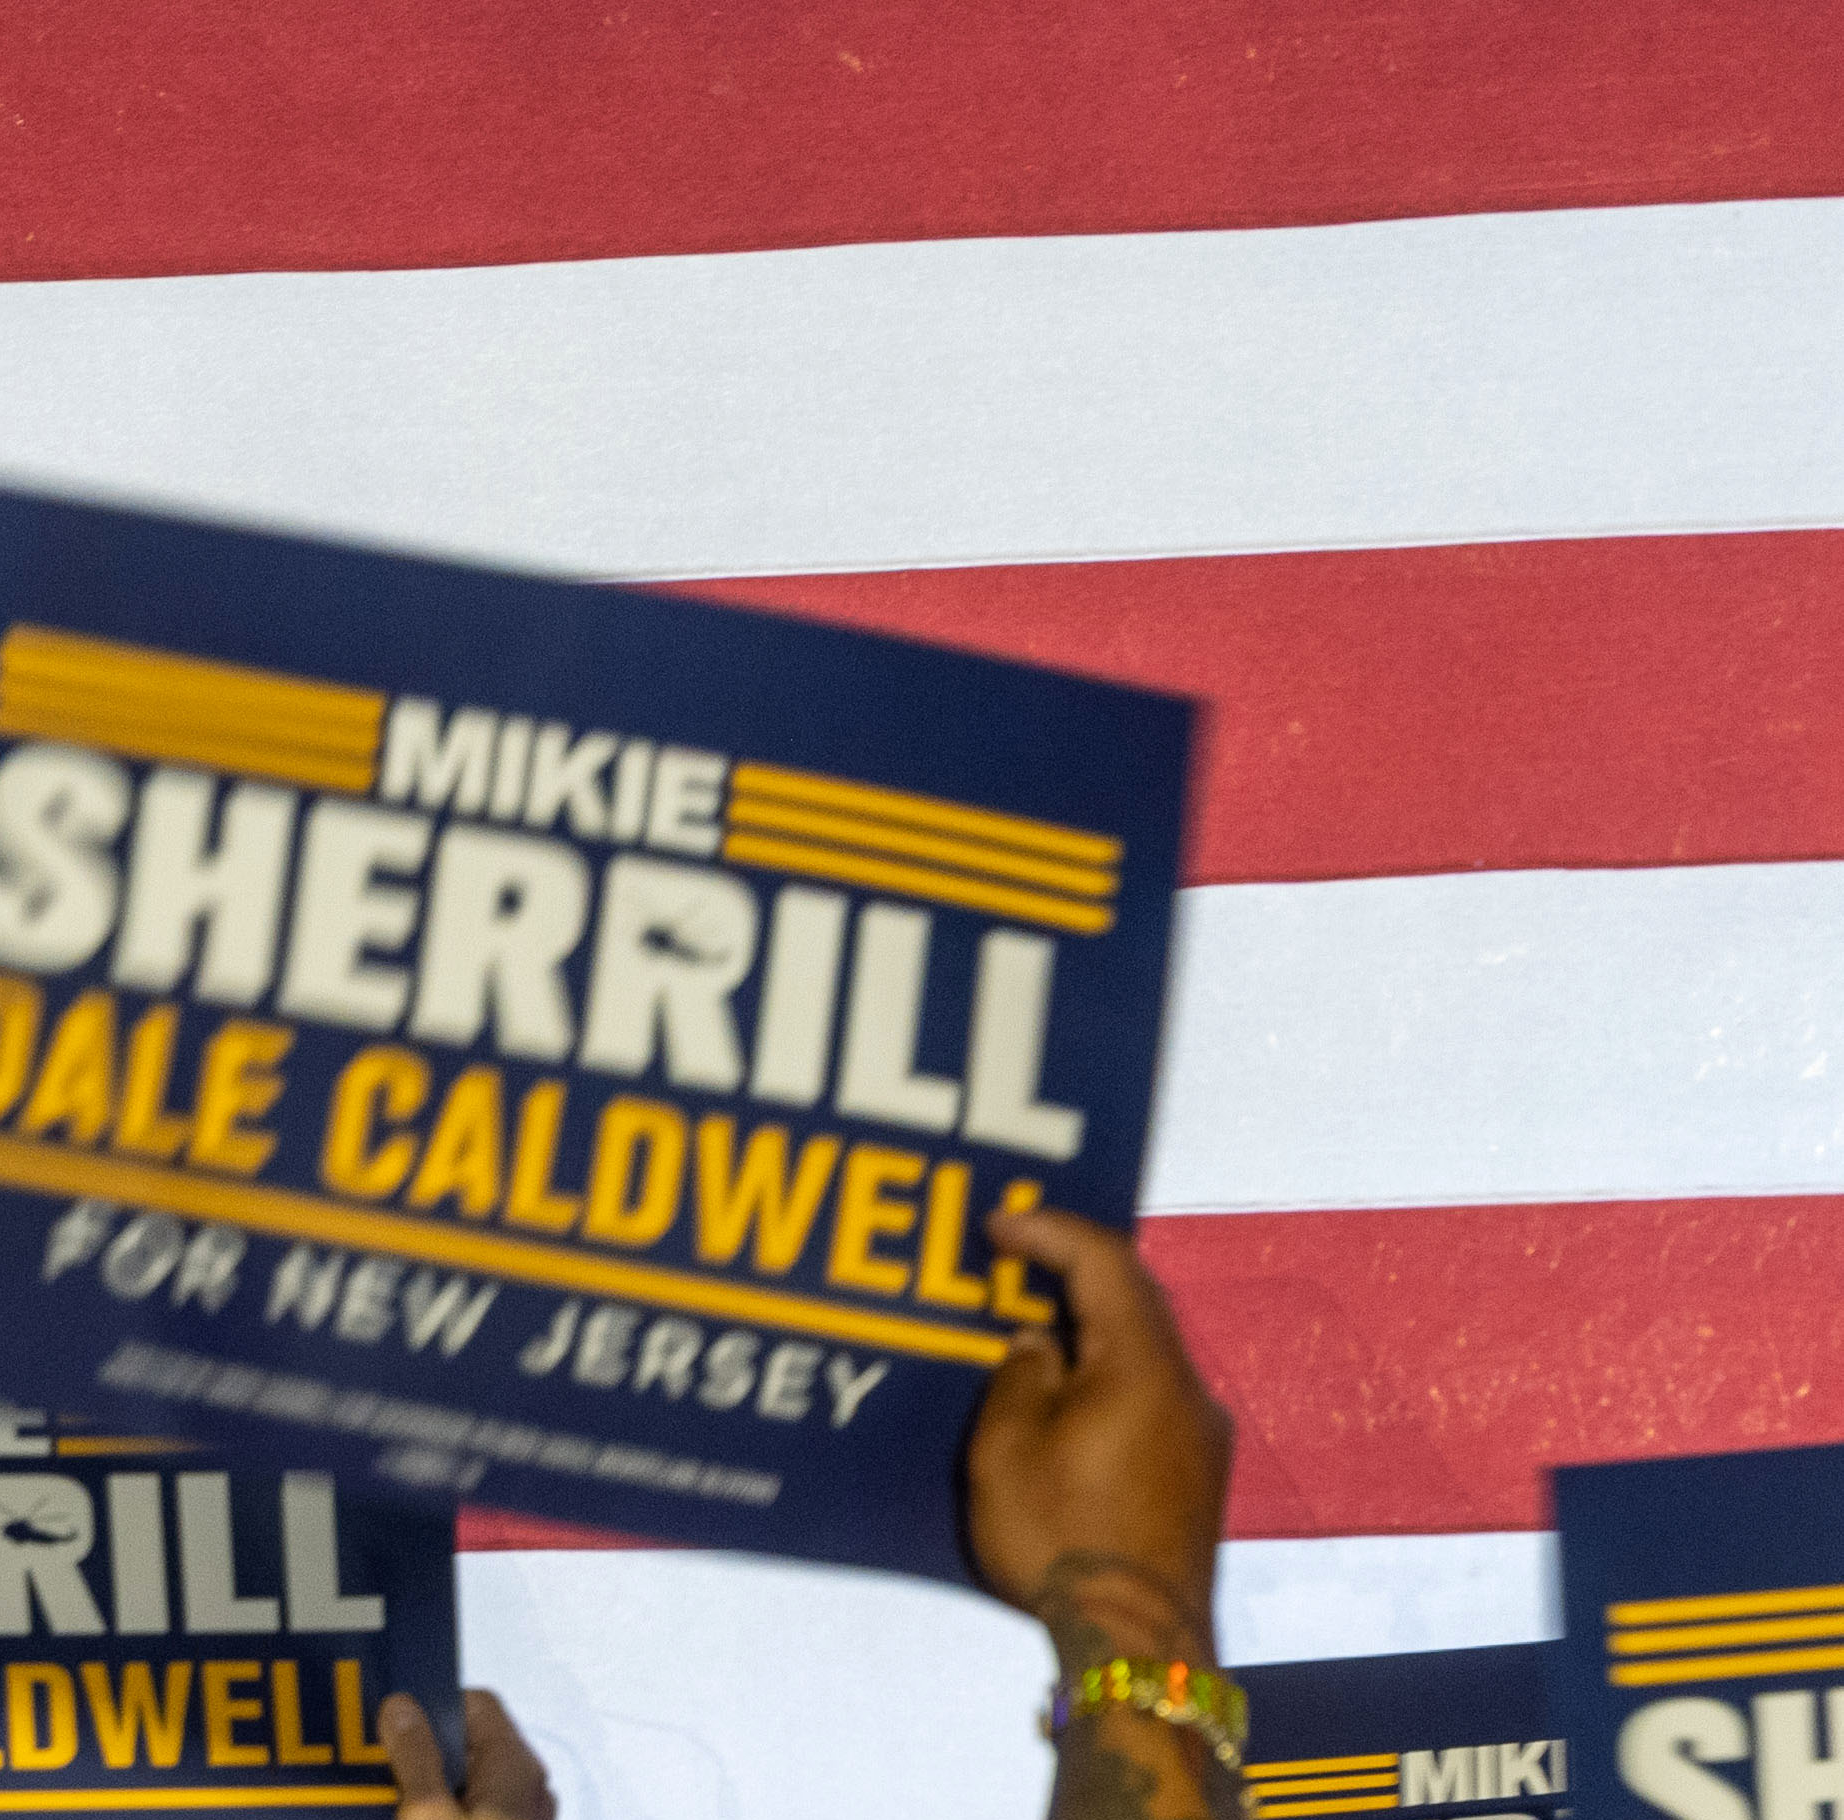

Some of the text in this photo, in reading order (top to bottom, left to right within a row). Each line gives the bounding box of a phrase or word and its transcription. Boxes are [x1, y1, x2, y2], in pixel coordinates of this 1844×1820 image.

[382, 696, 727, 854] MIKIE
[323, 1048, 1053, 1323] CALDWELL
[43, 1203, 242, 1311] FOR
[268, 1247, 500, 1358] NEW
[522, 1305, 887, 1426] JERSEY
